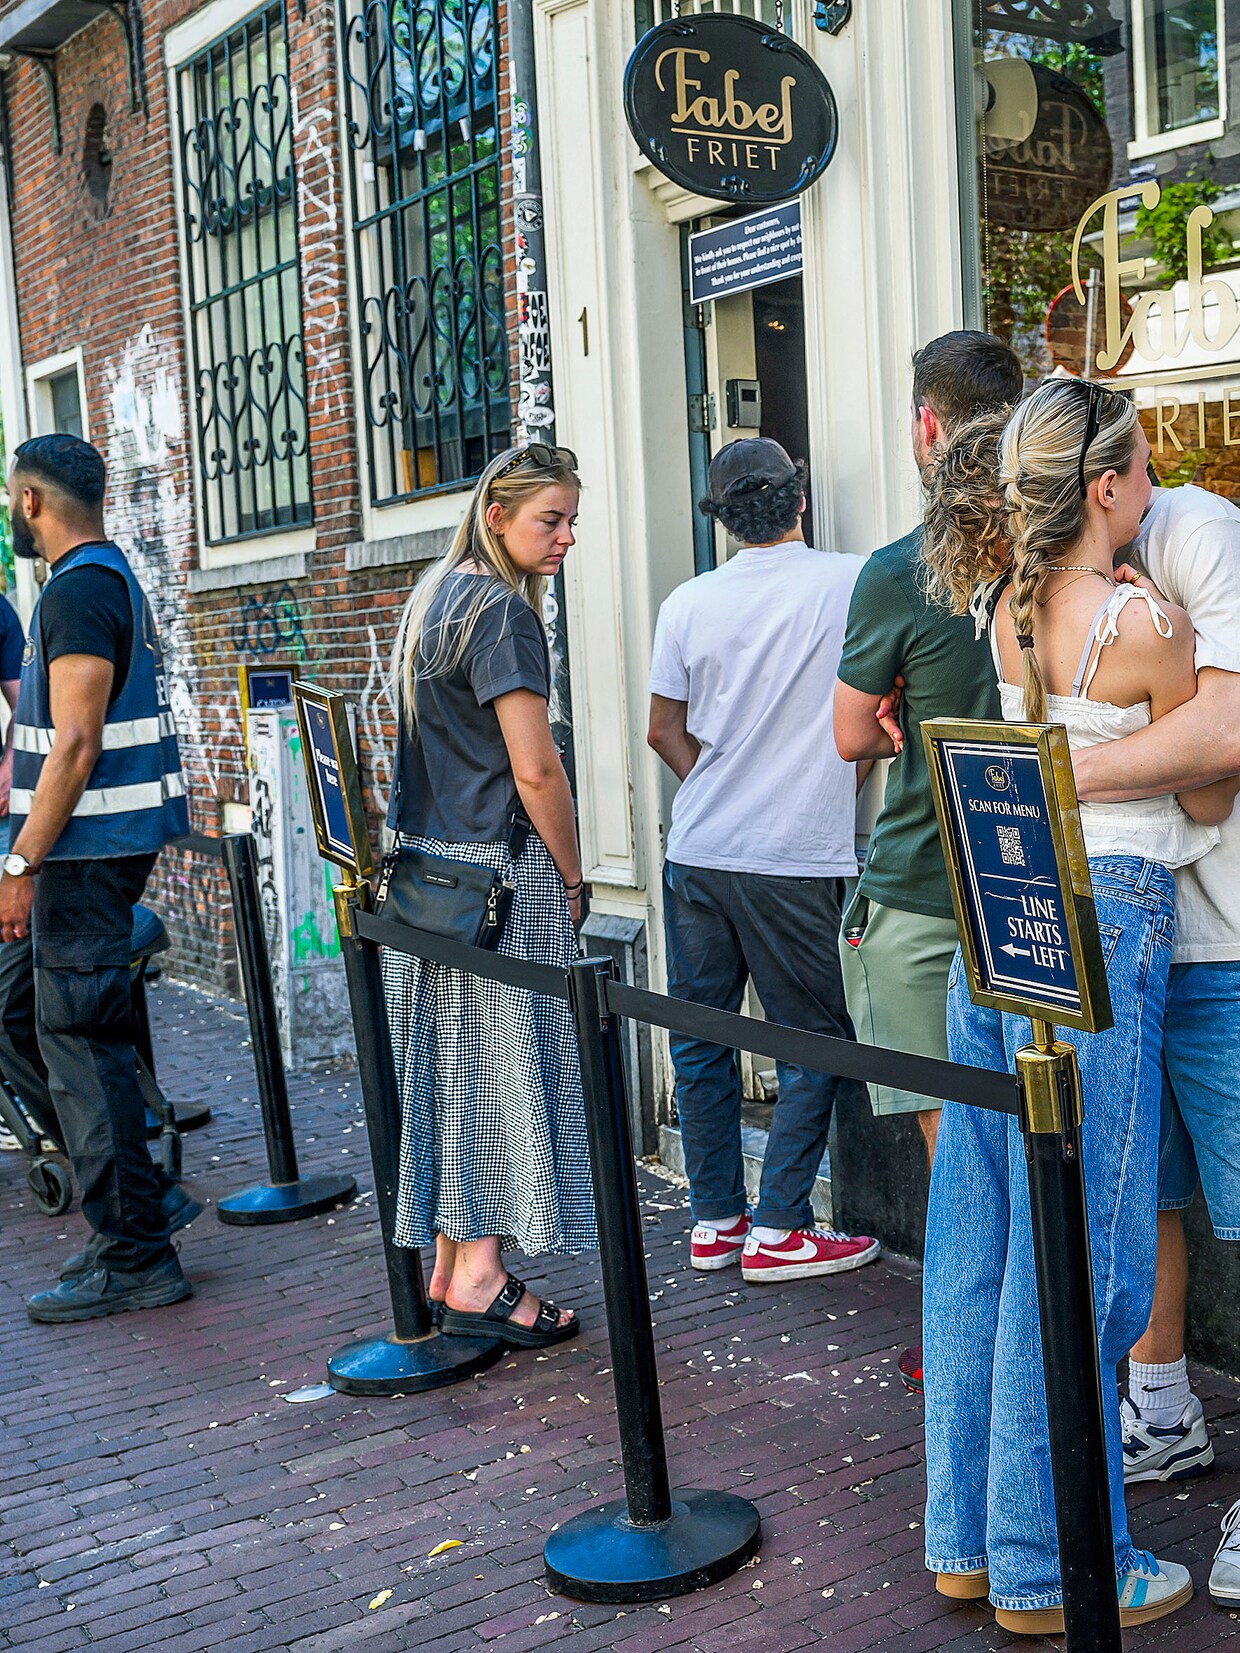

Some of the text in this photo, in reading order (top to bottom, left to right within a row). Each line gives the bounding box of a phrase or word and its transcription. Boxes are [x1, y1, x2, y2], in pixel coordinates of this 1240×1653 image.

[655, 47, 796, 144] Fabel
[687, 138, 781, 171] FRIET
[578, 306, 588, 357] 1
[968, 798, 1040, 819] SCAN FOR MENU
[1021, 894, 1058, 920] LINE
[1007, 916, 1062, 946] STARTS
[1032, 944, 1066, 970] LEFT
